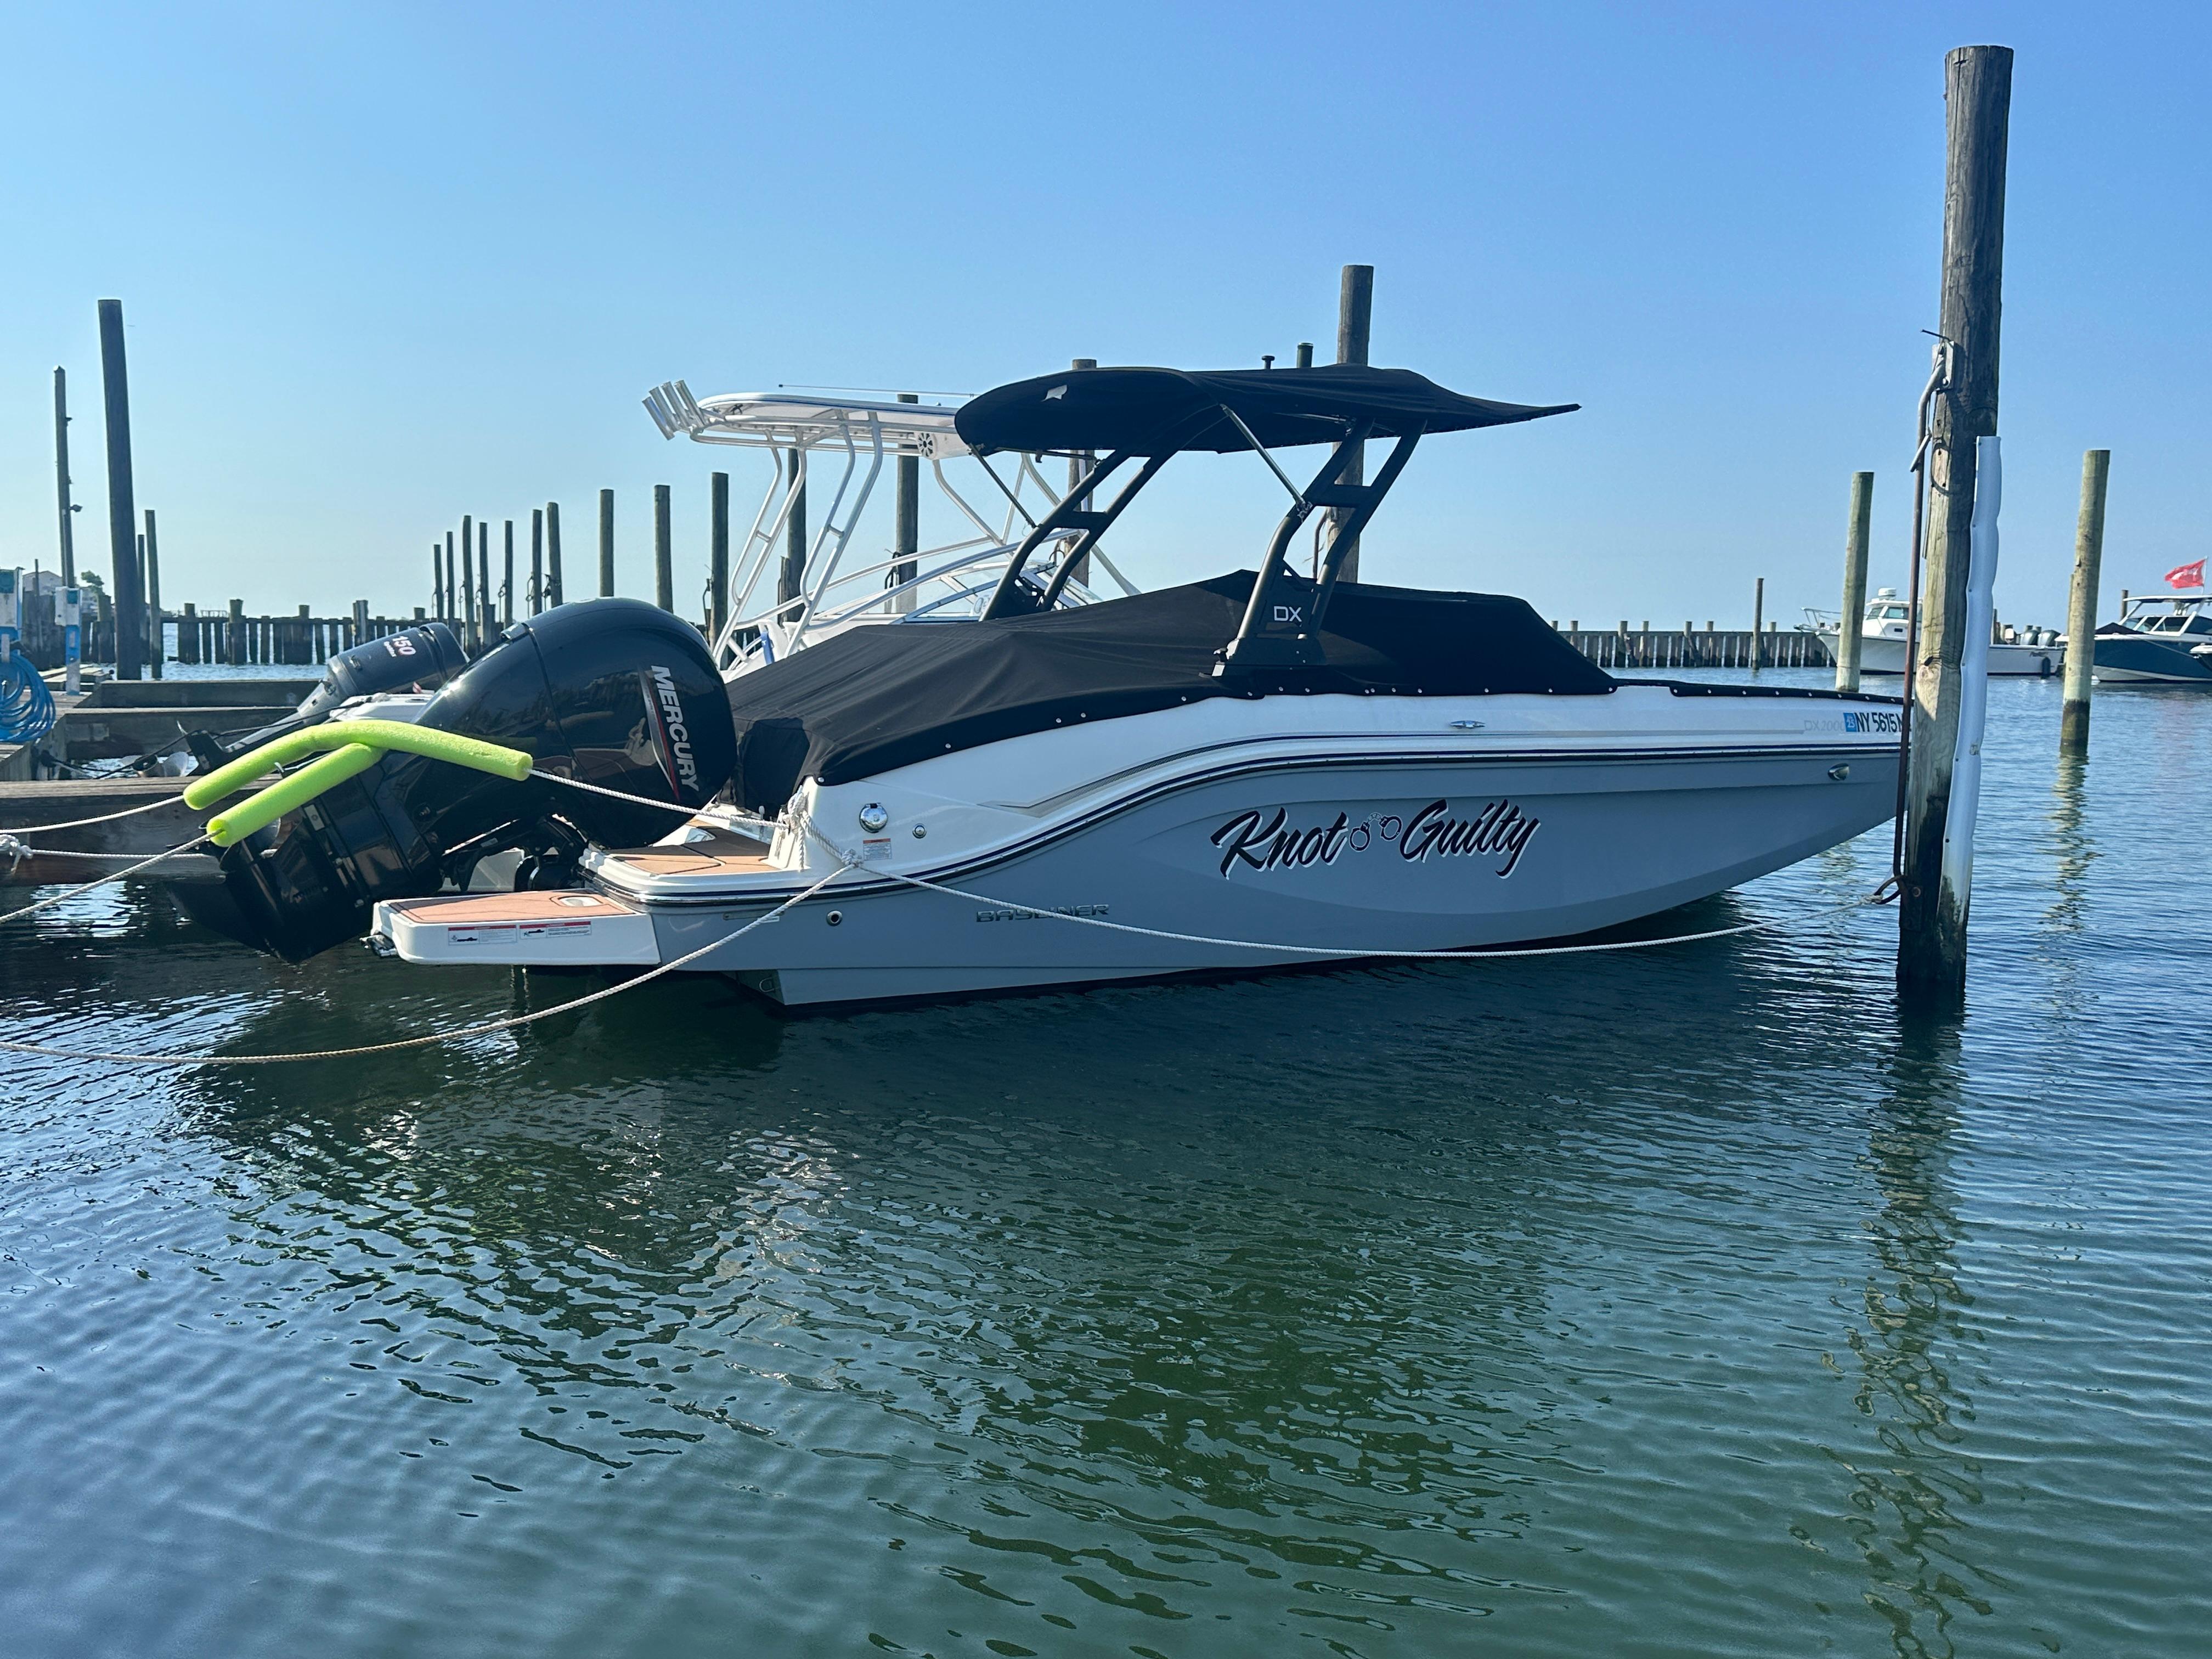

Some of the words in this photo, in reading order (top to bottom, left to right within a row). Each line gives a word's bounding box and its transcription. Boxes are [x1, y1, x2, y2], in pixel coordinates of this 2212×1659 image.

[1273, 606, 1302, 622] DX
[392, 636, 416, 655] 150
[651, 665, 699, 792] MERCURY
[1854, 712, 1870, 732] NY
[1210, 807, 1351, 880] Knot
[1400, 799, 1541, 879] Guilty
